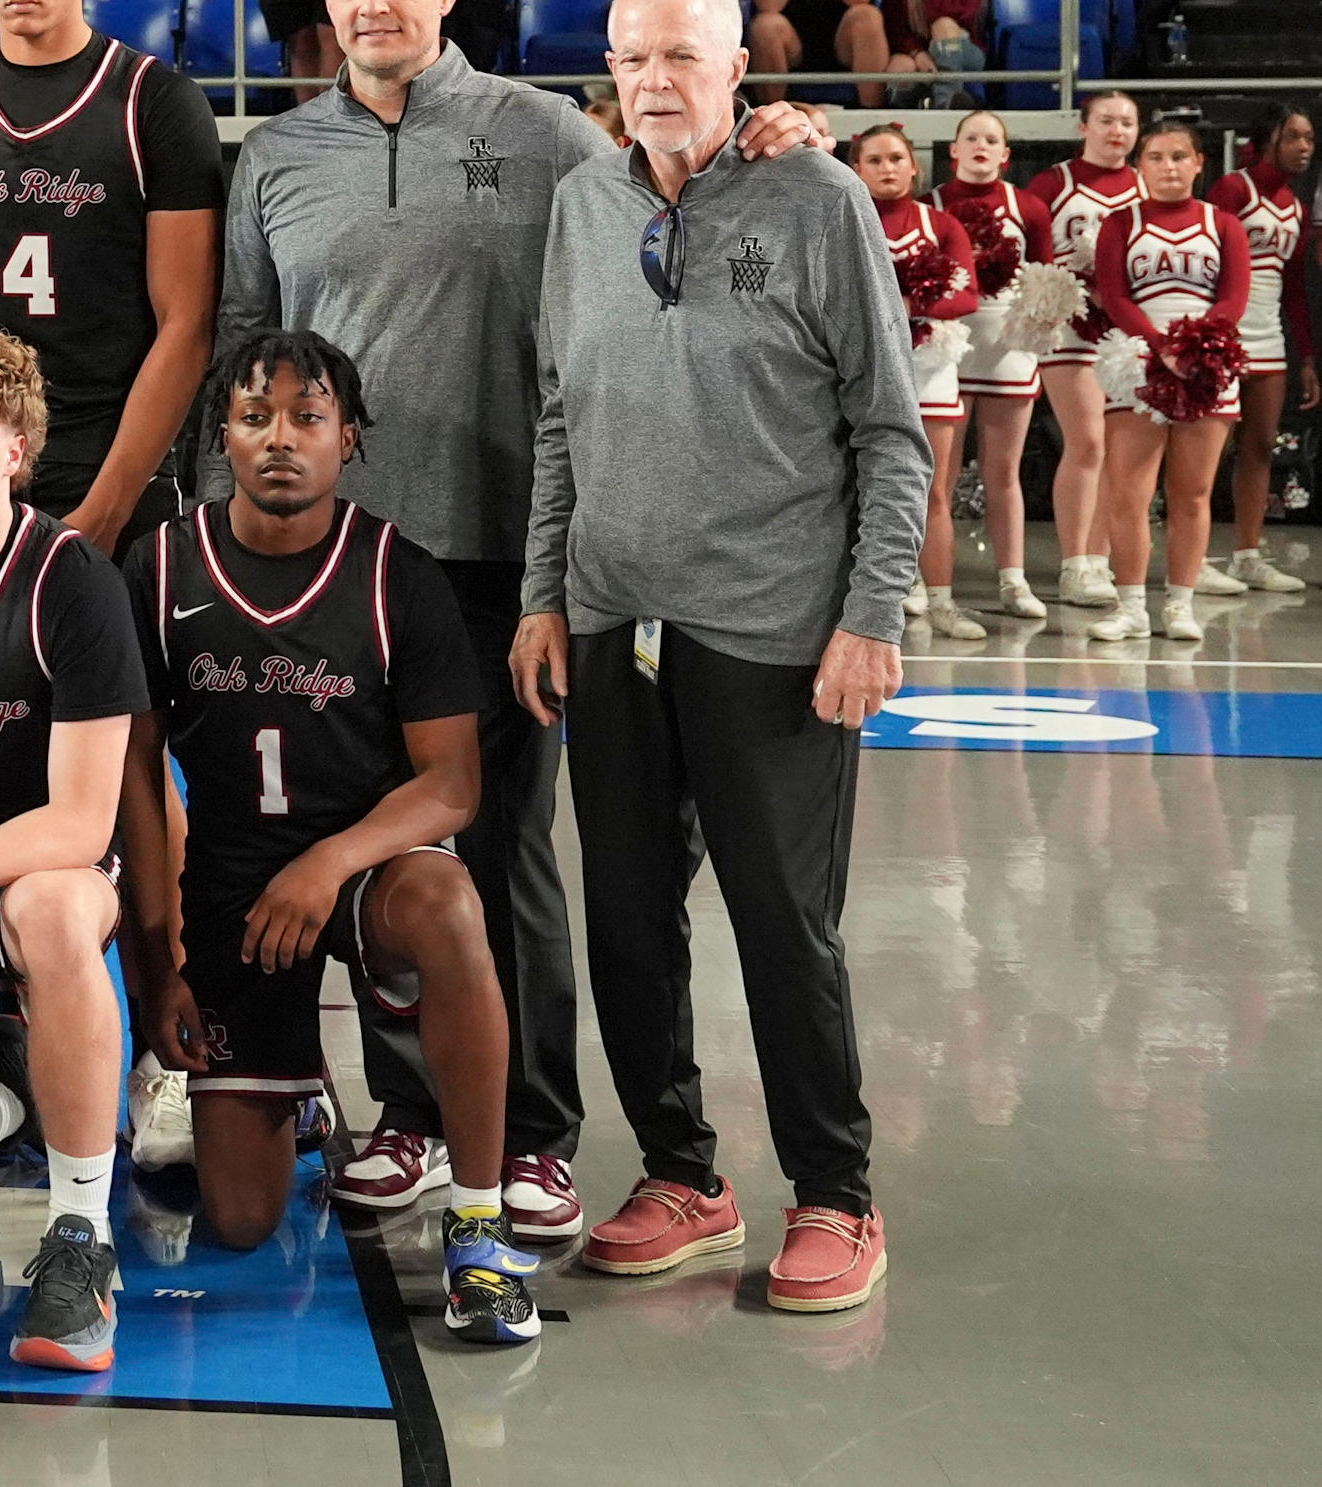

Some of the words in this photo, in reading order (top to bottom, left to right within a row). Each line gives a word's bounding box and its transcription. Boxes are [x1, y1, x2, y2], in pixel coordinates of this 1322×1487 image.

[16, 168, 106, 218] Ridge
[1, 233, 58, 316] 4
[1129, 248, 1220, 283] CATS
[187, 653, 247, 693] Oak
[255, 654, 356, 712] Ridge
[253, 727, 292, 816] 1
